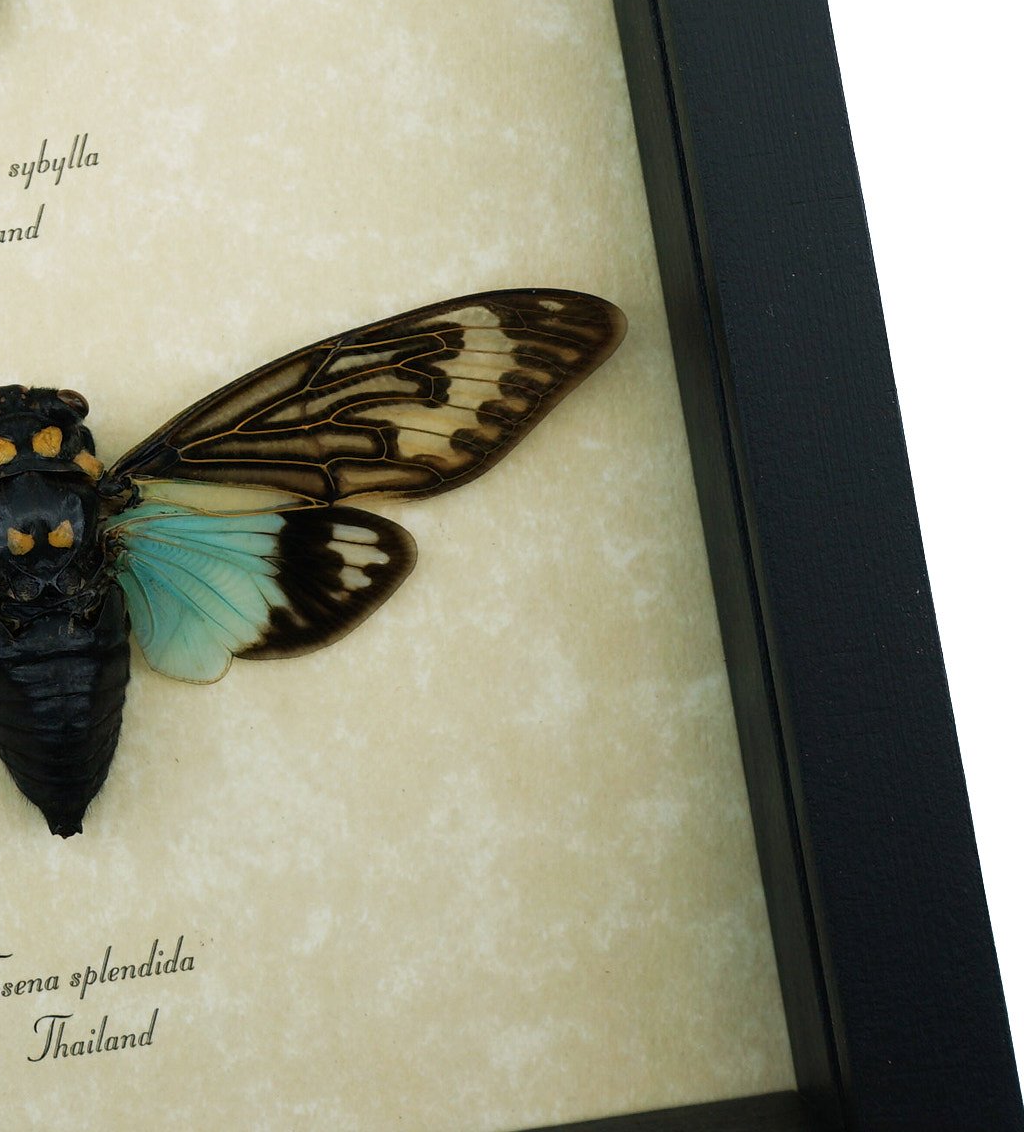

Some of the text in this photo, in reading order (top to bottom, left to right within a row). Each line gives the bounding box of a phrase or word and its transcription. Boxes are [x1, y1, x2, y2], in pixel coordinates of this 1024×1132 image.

[7, 132, 100, 190] sybylla
[68, 934, 195, 1000] splendida
[26, 1007, 160, 1063] Thailand
